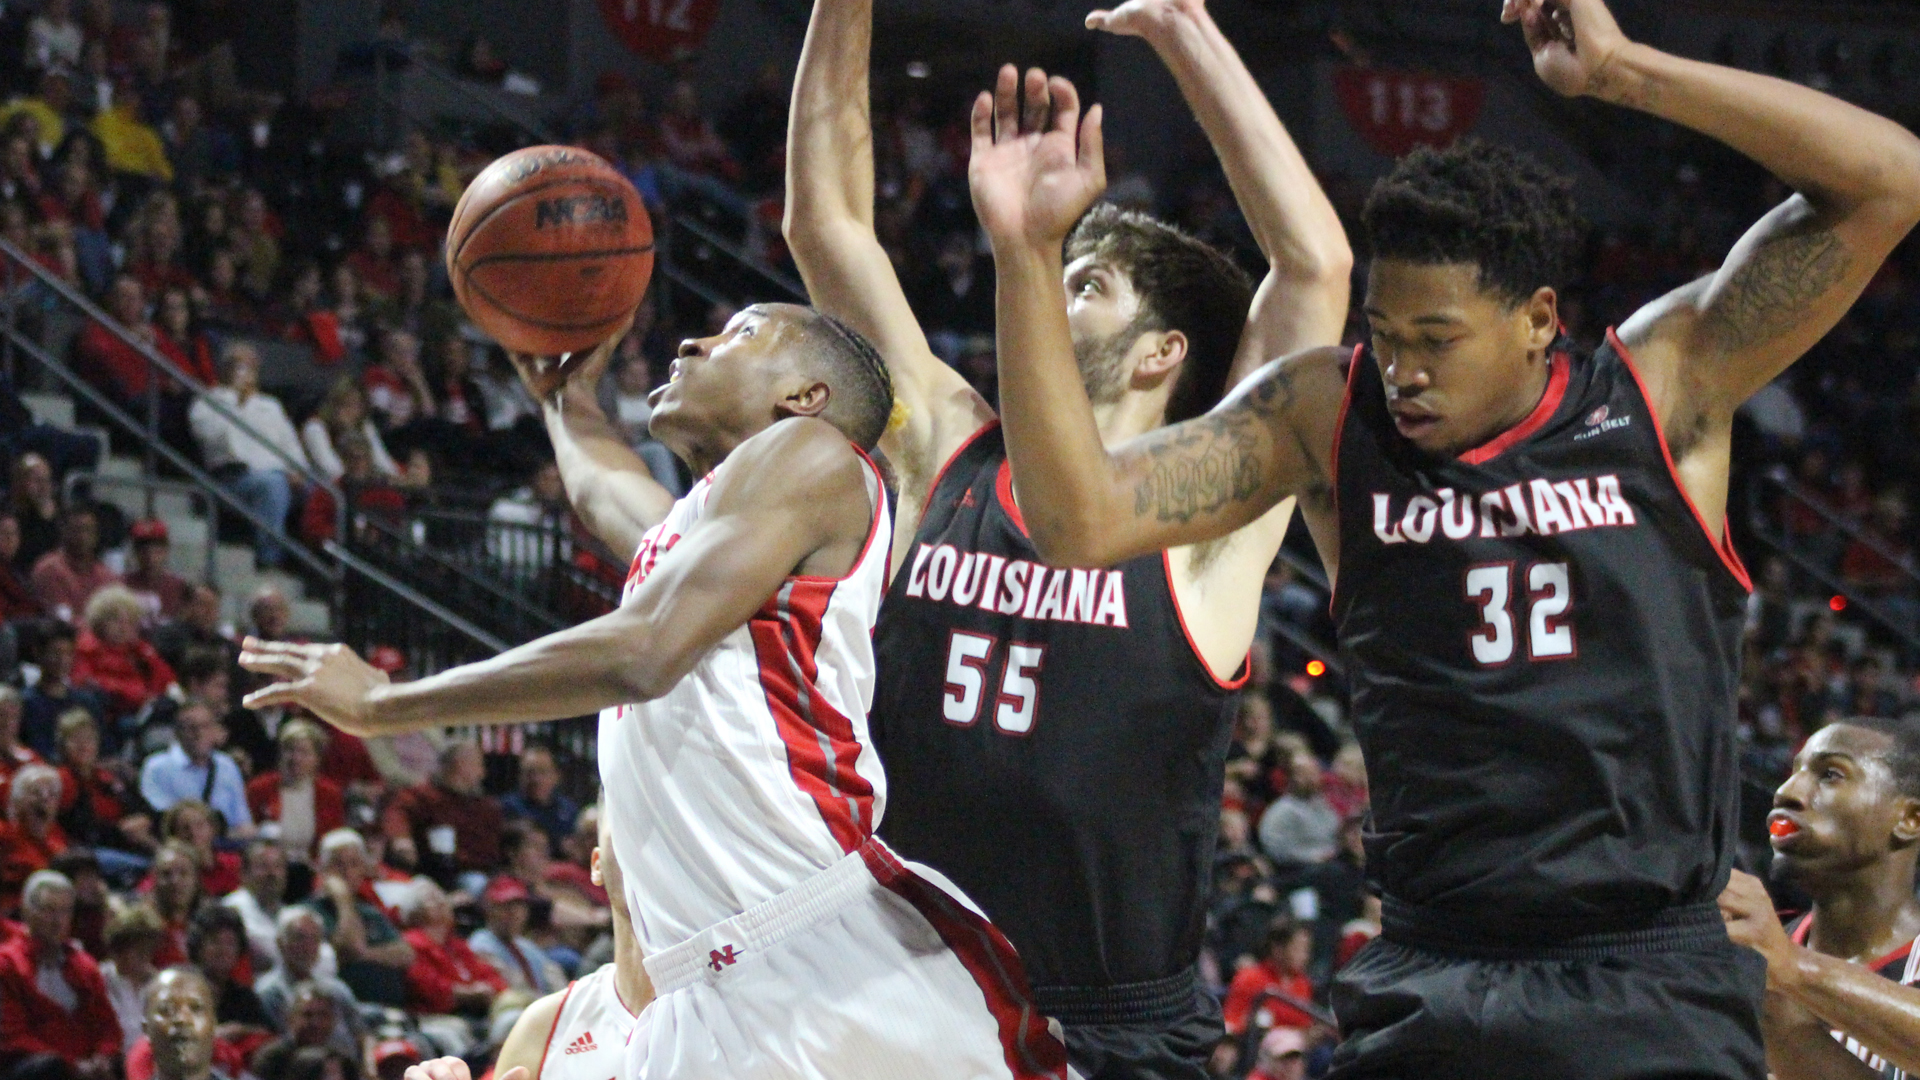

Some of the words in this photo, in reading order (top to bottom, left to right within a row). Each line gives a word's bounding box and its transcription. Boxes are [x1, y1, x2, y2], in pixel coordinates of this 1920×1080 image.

[1368, 79, 1449, 130] 113
[906, 543, 1129, 629] LOUISIANA
[1464, 560, 1577, 667] 32
[942, 628, 1047, 736] 55
